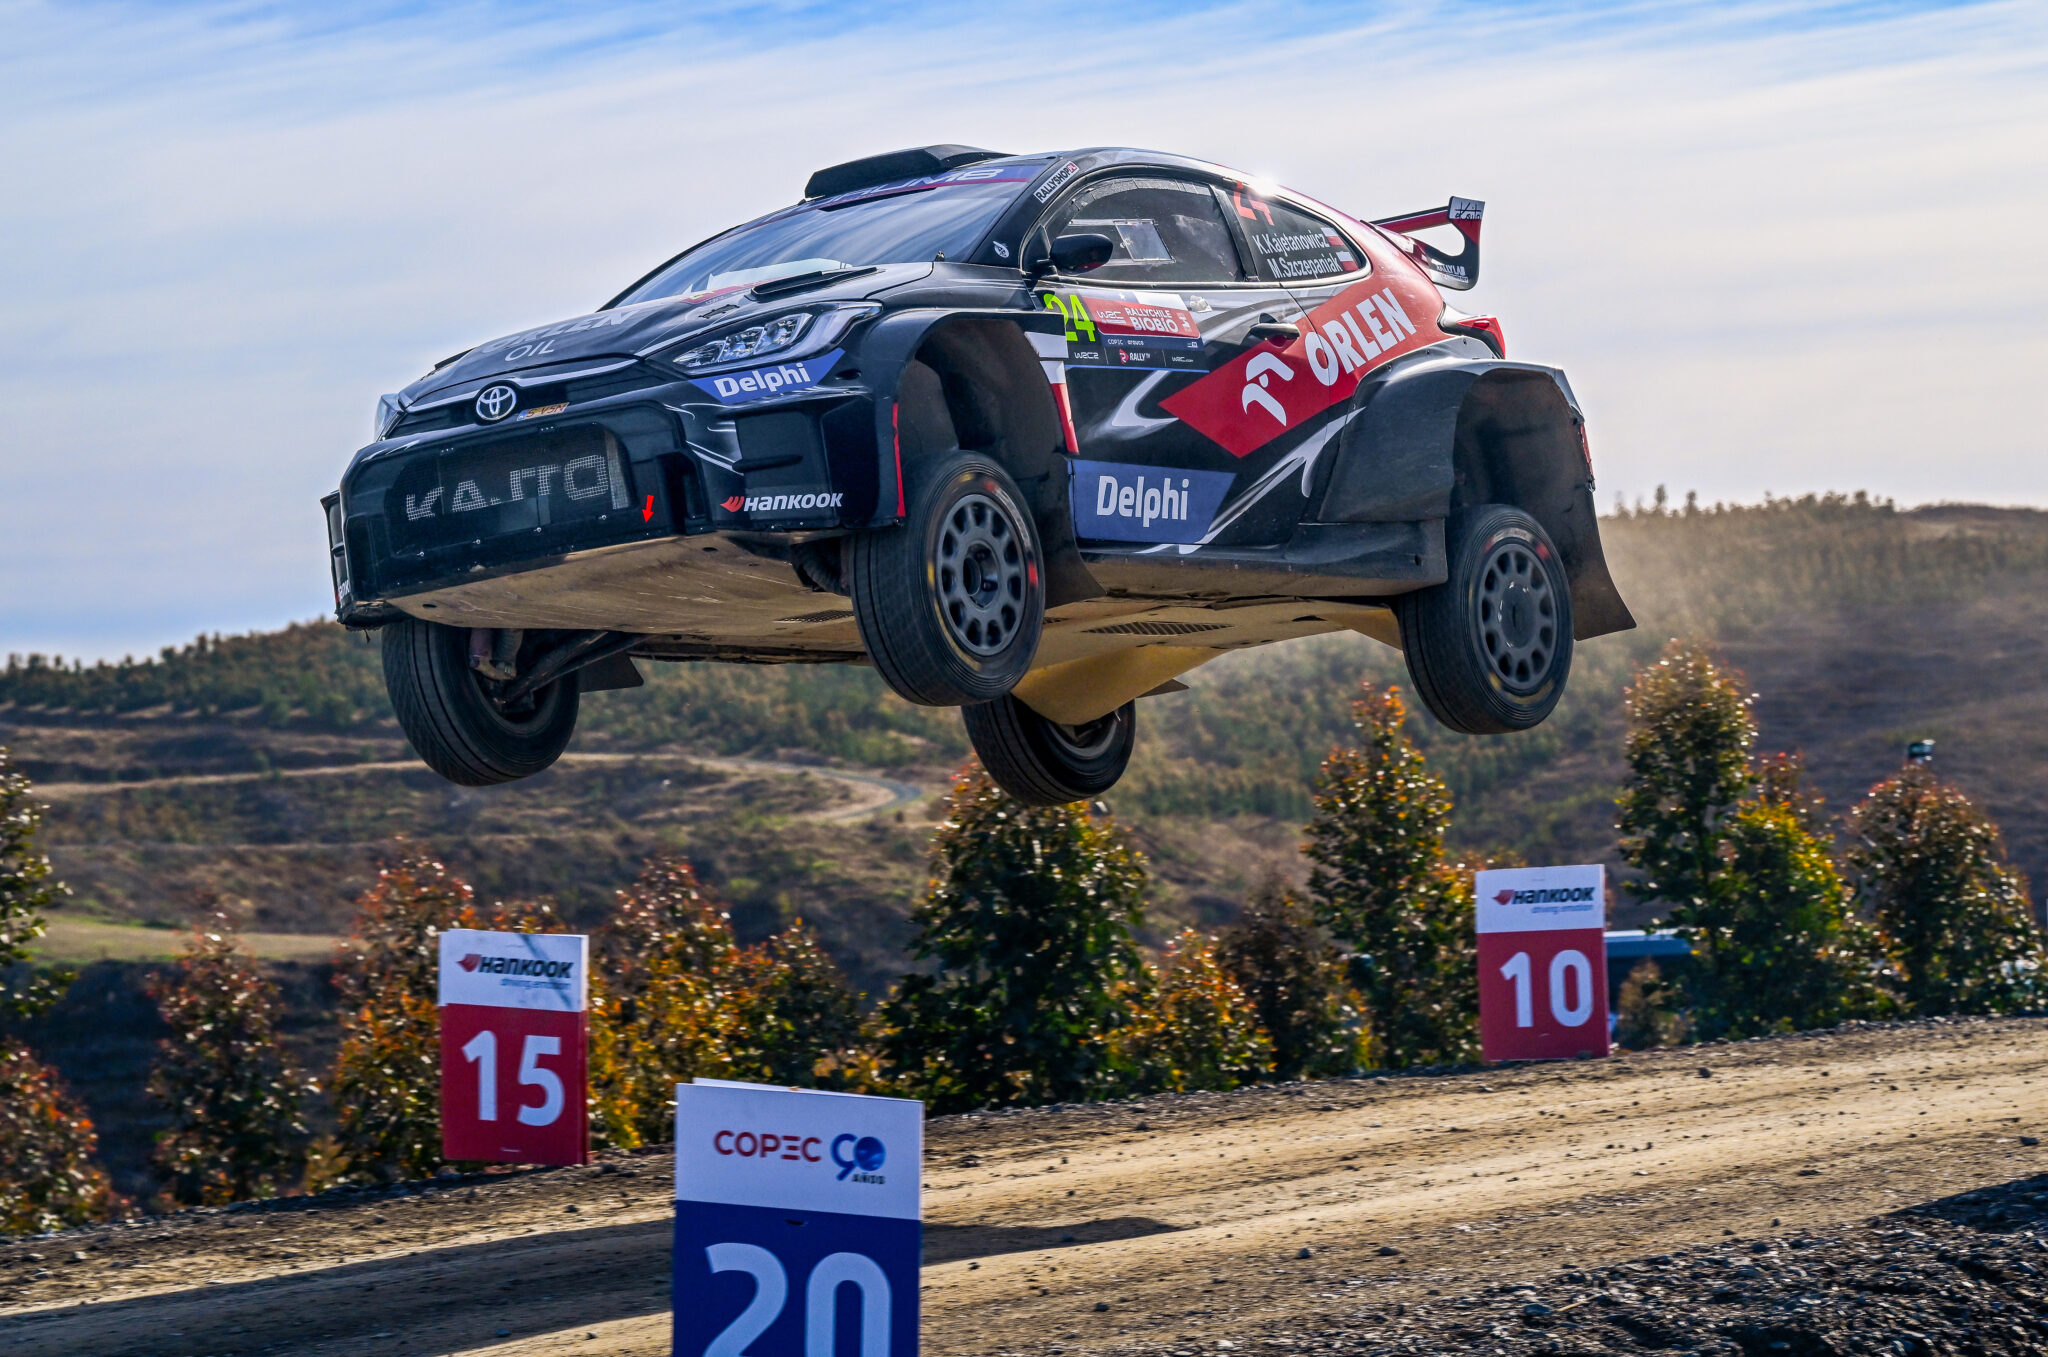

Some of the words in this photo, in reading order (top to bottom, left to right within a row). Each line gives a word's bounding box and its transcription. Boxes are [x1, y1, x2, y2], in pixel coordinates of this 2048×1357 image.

[1252, 229, 1330, 257] K.Kajetanowicz
[1266, 252, 1343, 279] M.Szczepaniak
[1043, 293, 1096, 342] 24
[1304, 287, 1417, 386] ORLEN
[504, 339, 556, 362] OIL
[1073, 351, 1100, 360] WRC2
[713, 362, 811, 398] Delphi
[1096, 475, 1190, 528] Delphi
[1500, 949, 1594, 1028] 10
[462, 1030, 565, 1127] 15
[713, 1129, 823, 1163] COPEC
[702, 1241, 893, 1357] 20
